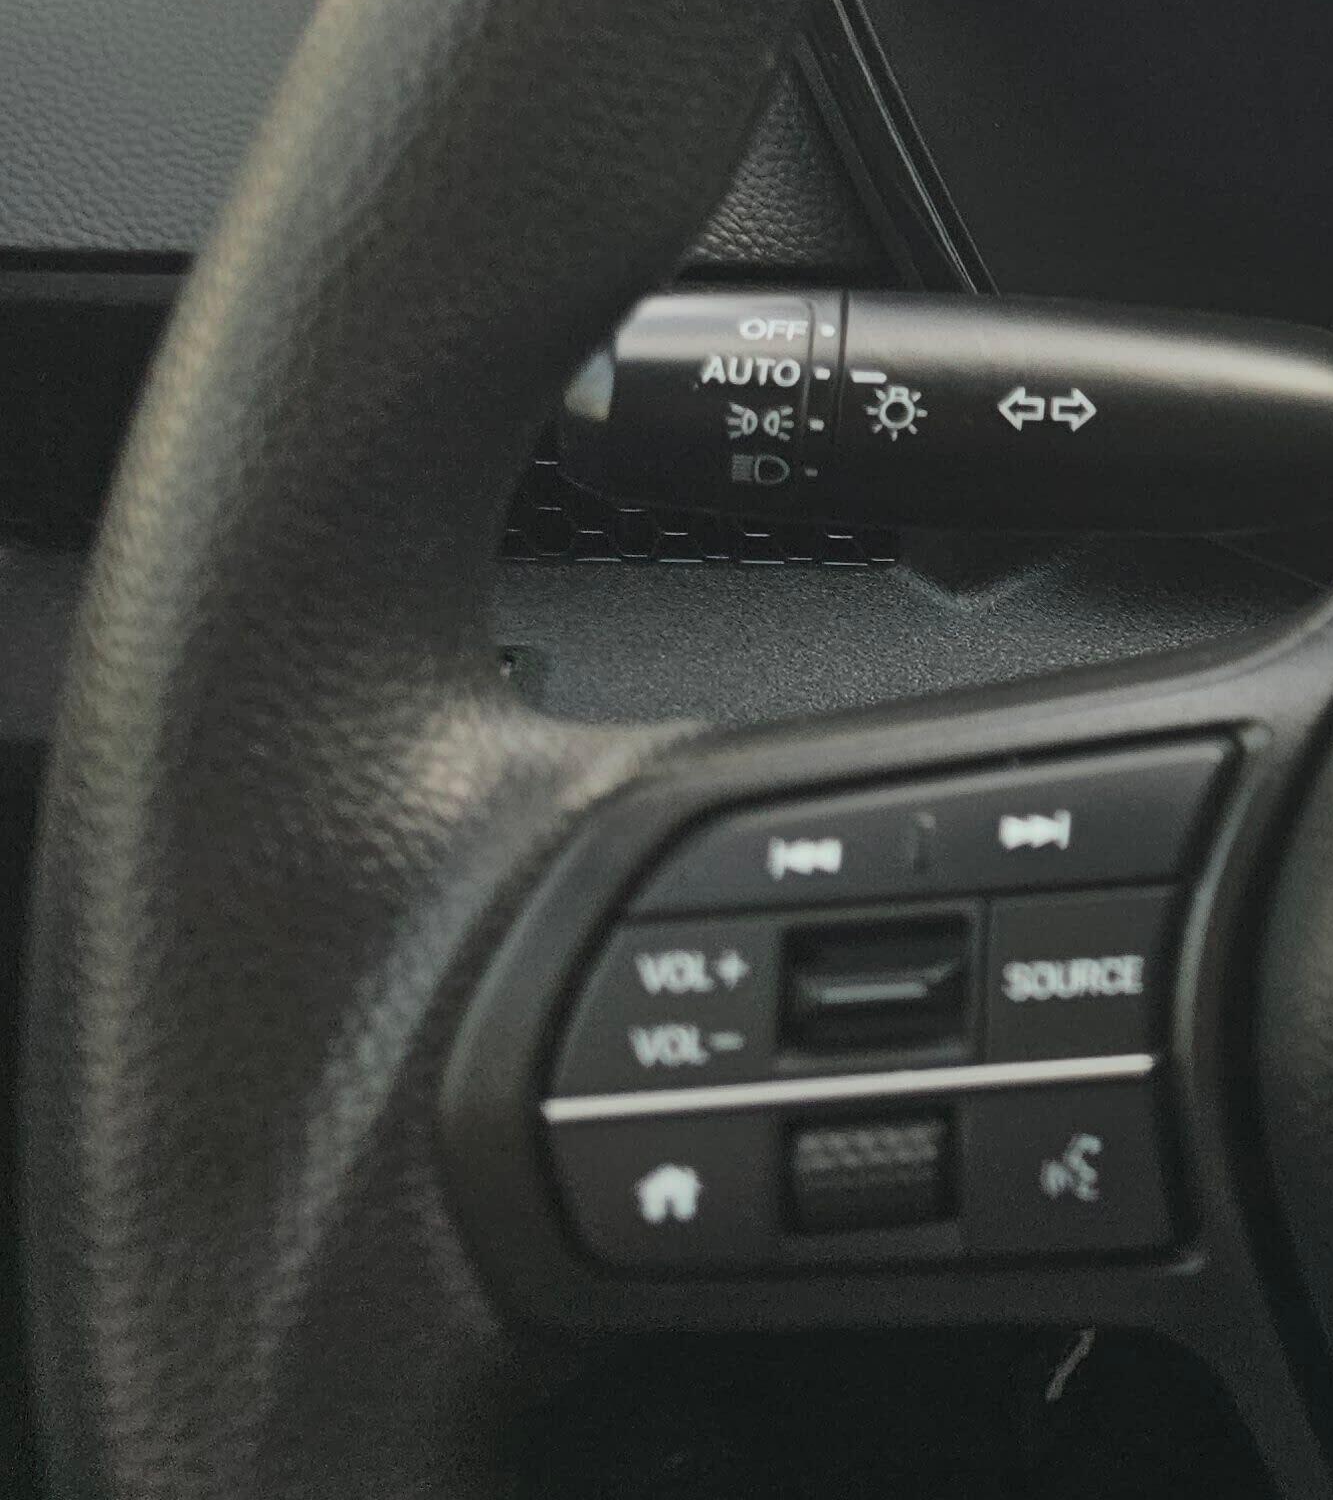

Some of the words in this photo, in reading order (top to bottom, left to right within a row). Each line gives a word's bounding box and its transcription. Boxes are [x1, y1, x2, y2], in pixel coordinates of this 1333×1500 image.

[740, 318, 807, 341] OFF
[701, 356, 801, 387] AUTO
[1007, 955, 1144, 1002] SOURCE
